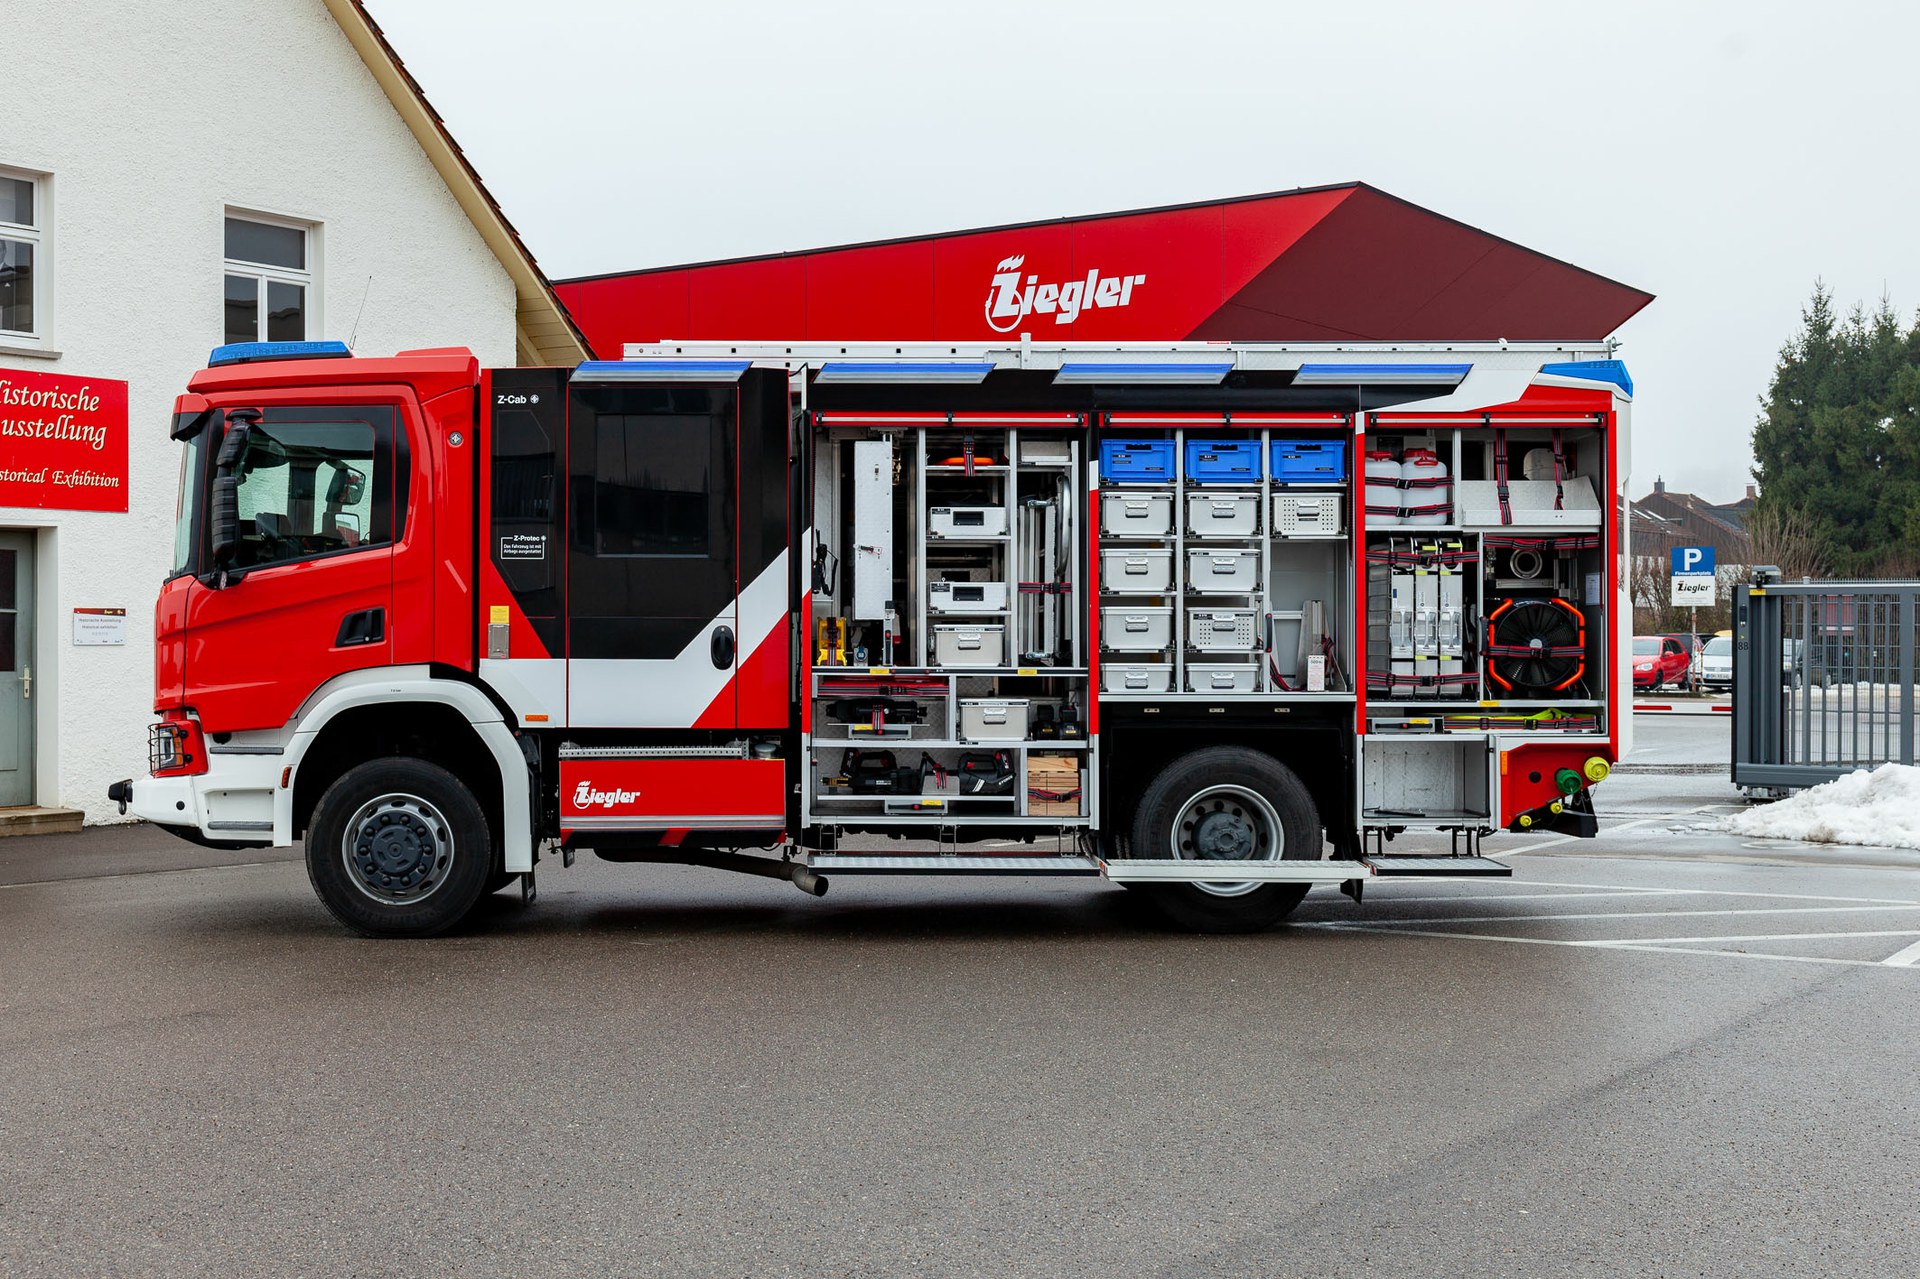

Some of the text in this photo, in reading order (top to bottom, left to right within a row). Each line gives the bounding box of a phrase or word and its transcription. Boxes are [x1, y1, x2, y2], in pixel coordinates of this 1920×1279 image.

[990, 268, 1146, 326] Ziegler
[497, 394, 527, 404] Z-Cab
[1, 414, 108, 451] usstellung
[0, 467, 120, 489] storical Exhibition
[1684, 548, 1703, 571] P
[1677, 582, 1711, 594] Ziegler
[575, 785, 641, 808] Ziegler
